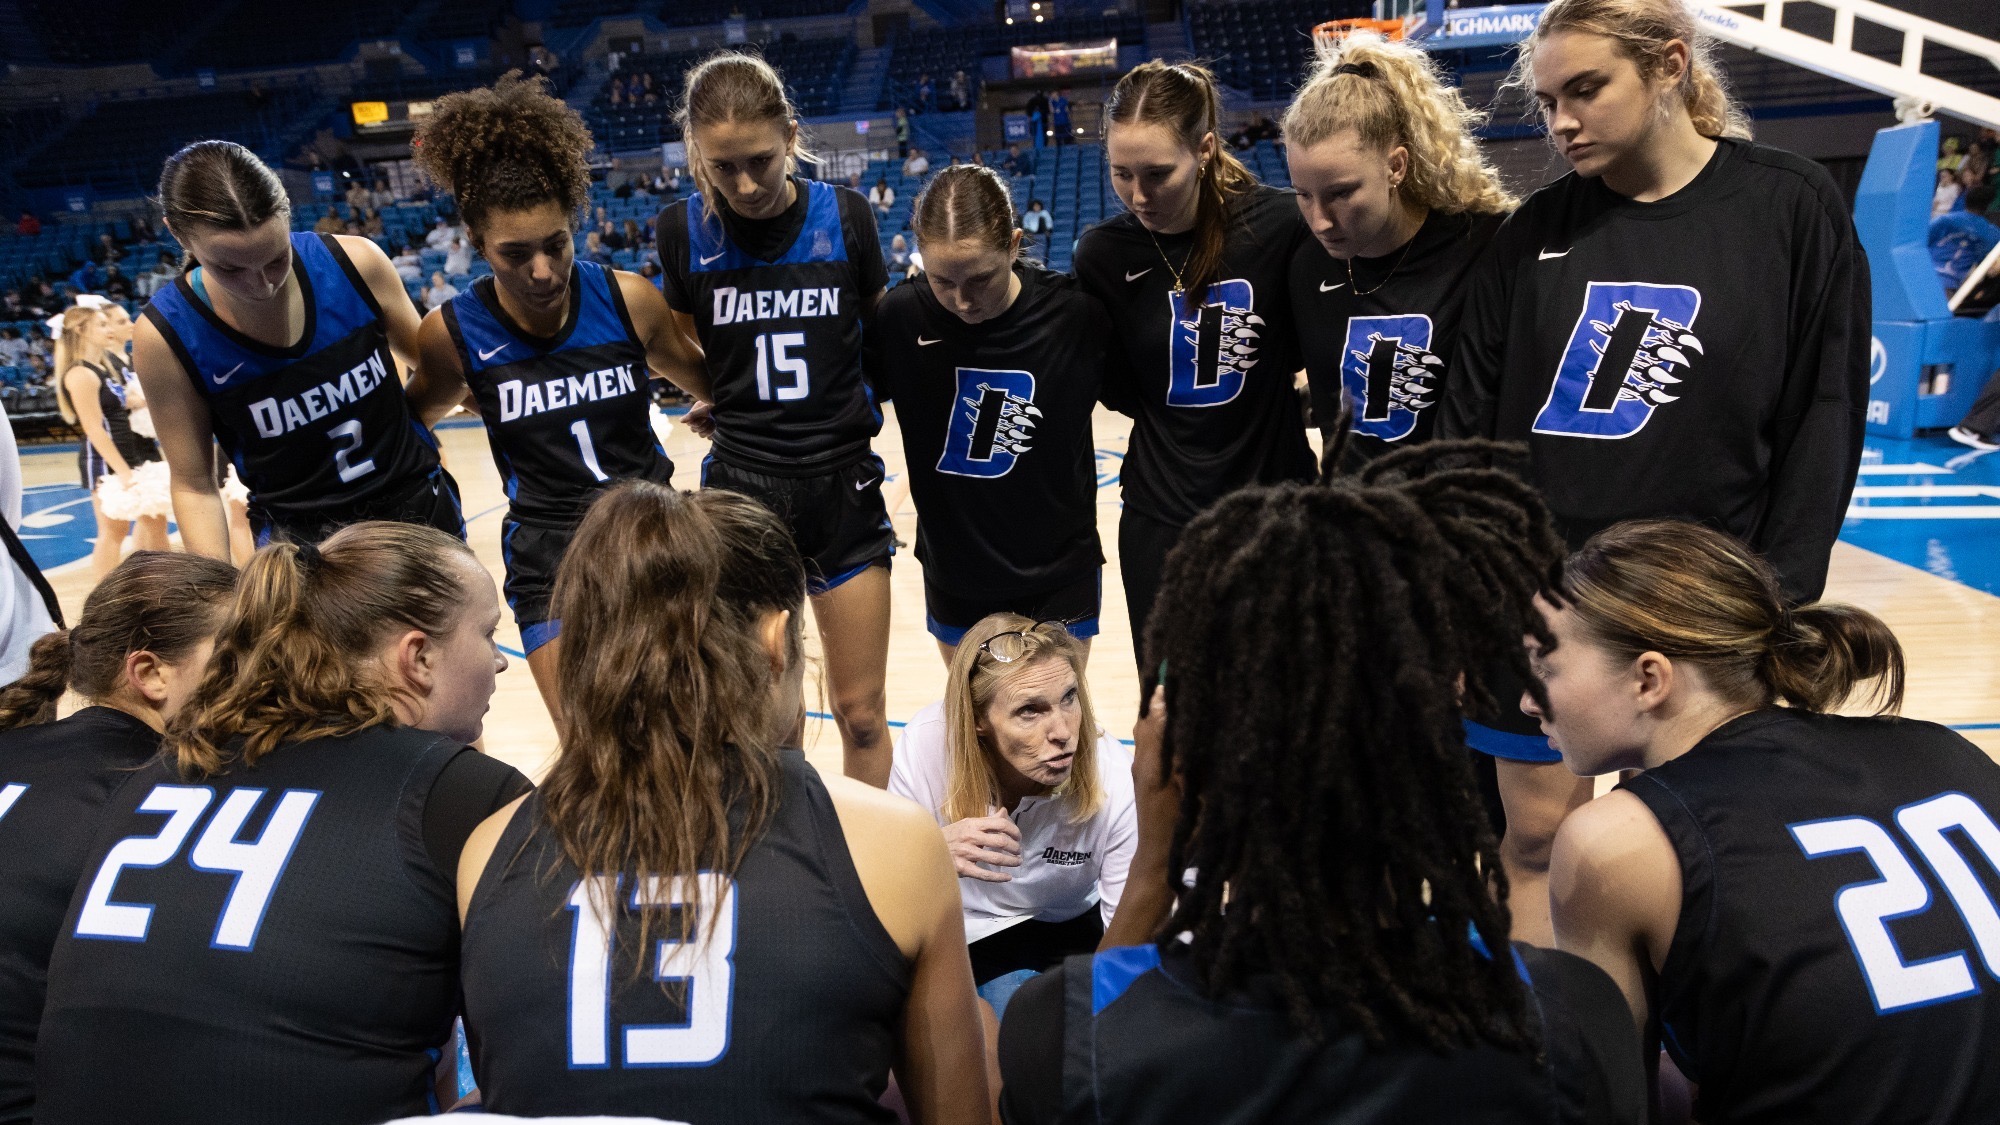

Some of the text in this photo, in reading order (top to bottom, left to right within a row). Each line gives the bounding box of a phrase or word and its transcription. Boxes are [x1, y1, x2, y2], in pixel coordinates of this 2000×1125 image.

[712, 286, 840, 326] DAEMEN
[248, 348, 388, 439] DAEMEN
[497, 363, 636, 423] DAEMEN
[755, 332, 809, 401] 15
[1534, 281, 1702, 439] D
[326, 419, 377, 484] 2
[569, 418, 611, 483] 1
[936, 367, 1036, 478] D
[73, 782, 325, 952] 24
[1042, 846, 1091, 861] DAEMEN
[1785, 790, 2000, 1016] 20
[565, 869, 739, 1070] 13
